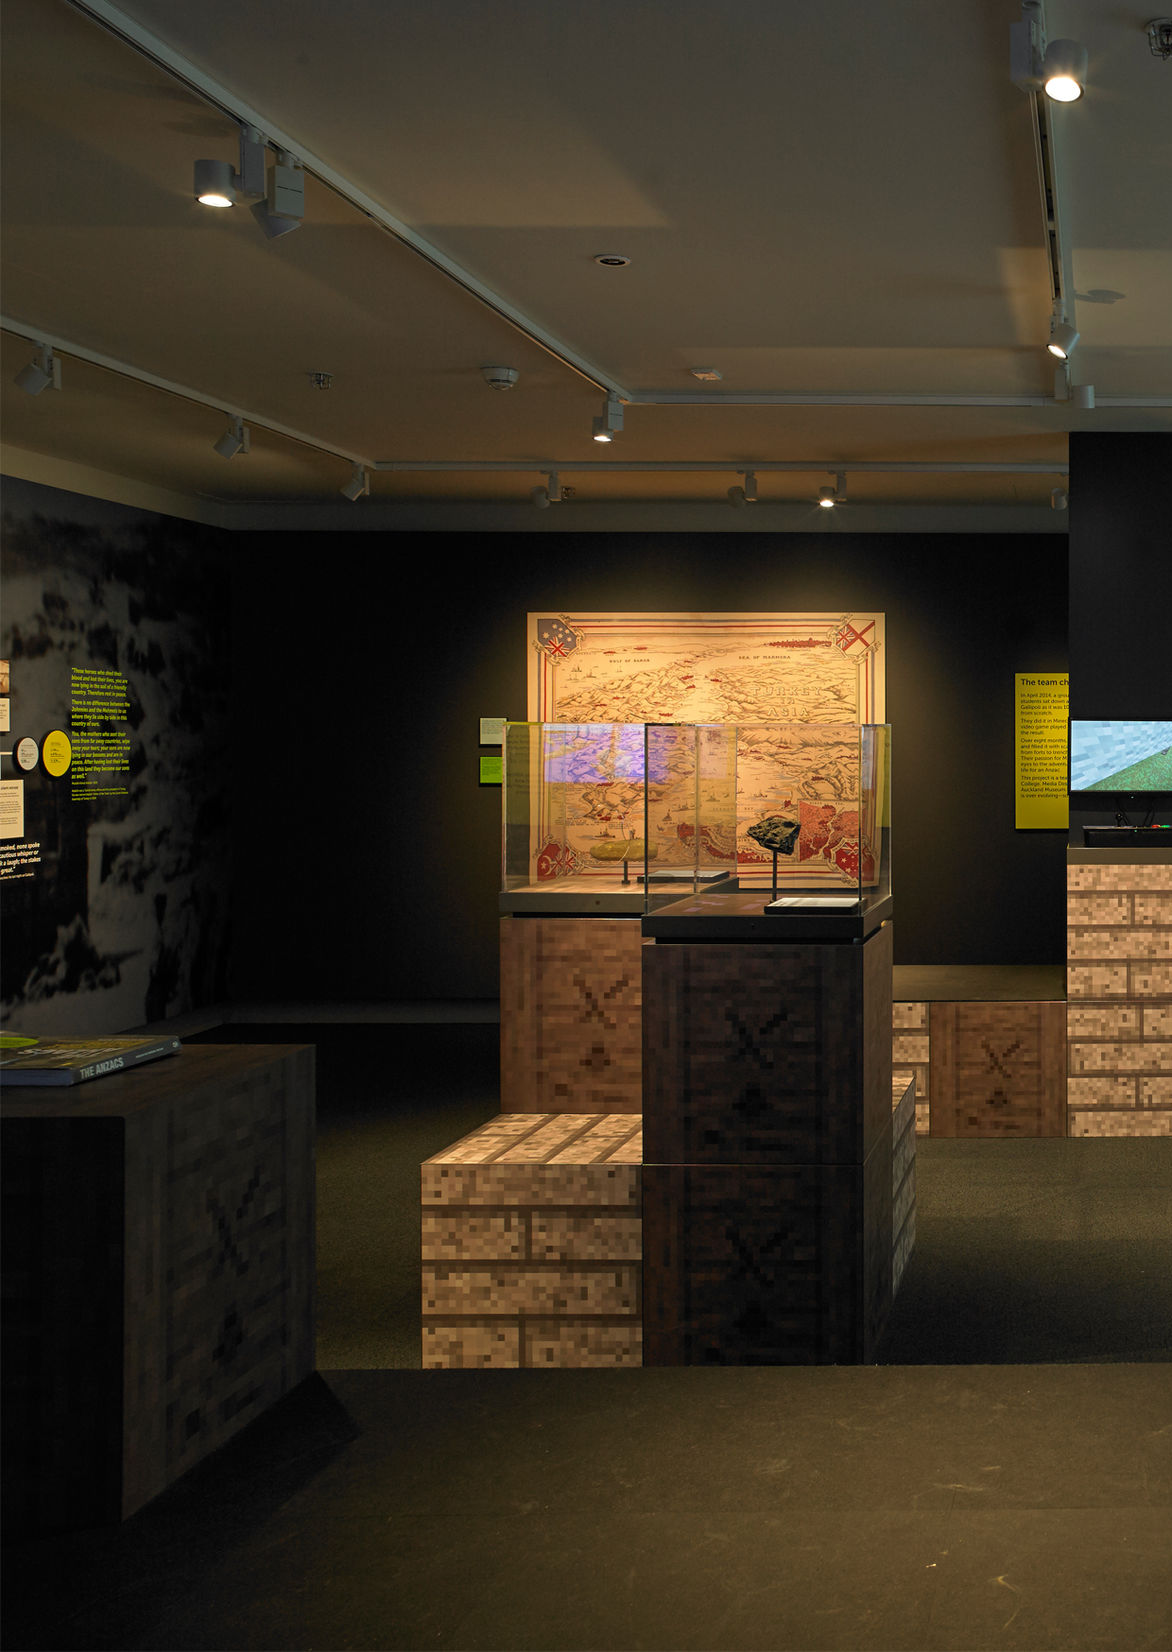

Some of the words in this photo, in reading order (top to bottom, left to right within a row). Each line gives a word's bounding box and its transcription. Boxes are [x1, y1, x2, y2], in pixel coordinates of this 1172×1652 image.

[750, 686, 821, 696] TURKEY
[766, 707, 810, 717] ASIA
[80, 1066, 95, 1080] THE
[96, 1058, 124, 1074] ANZACS
